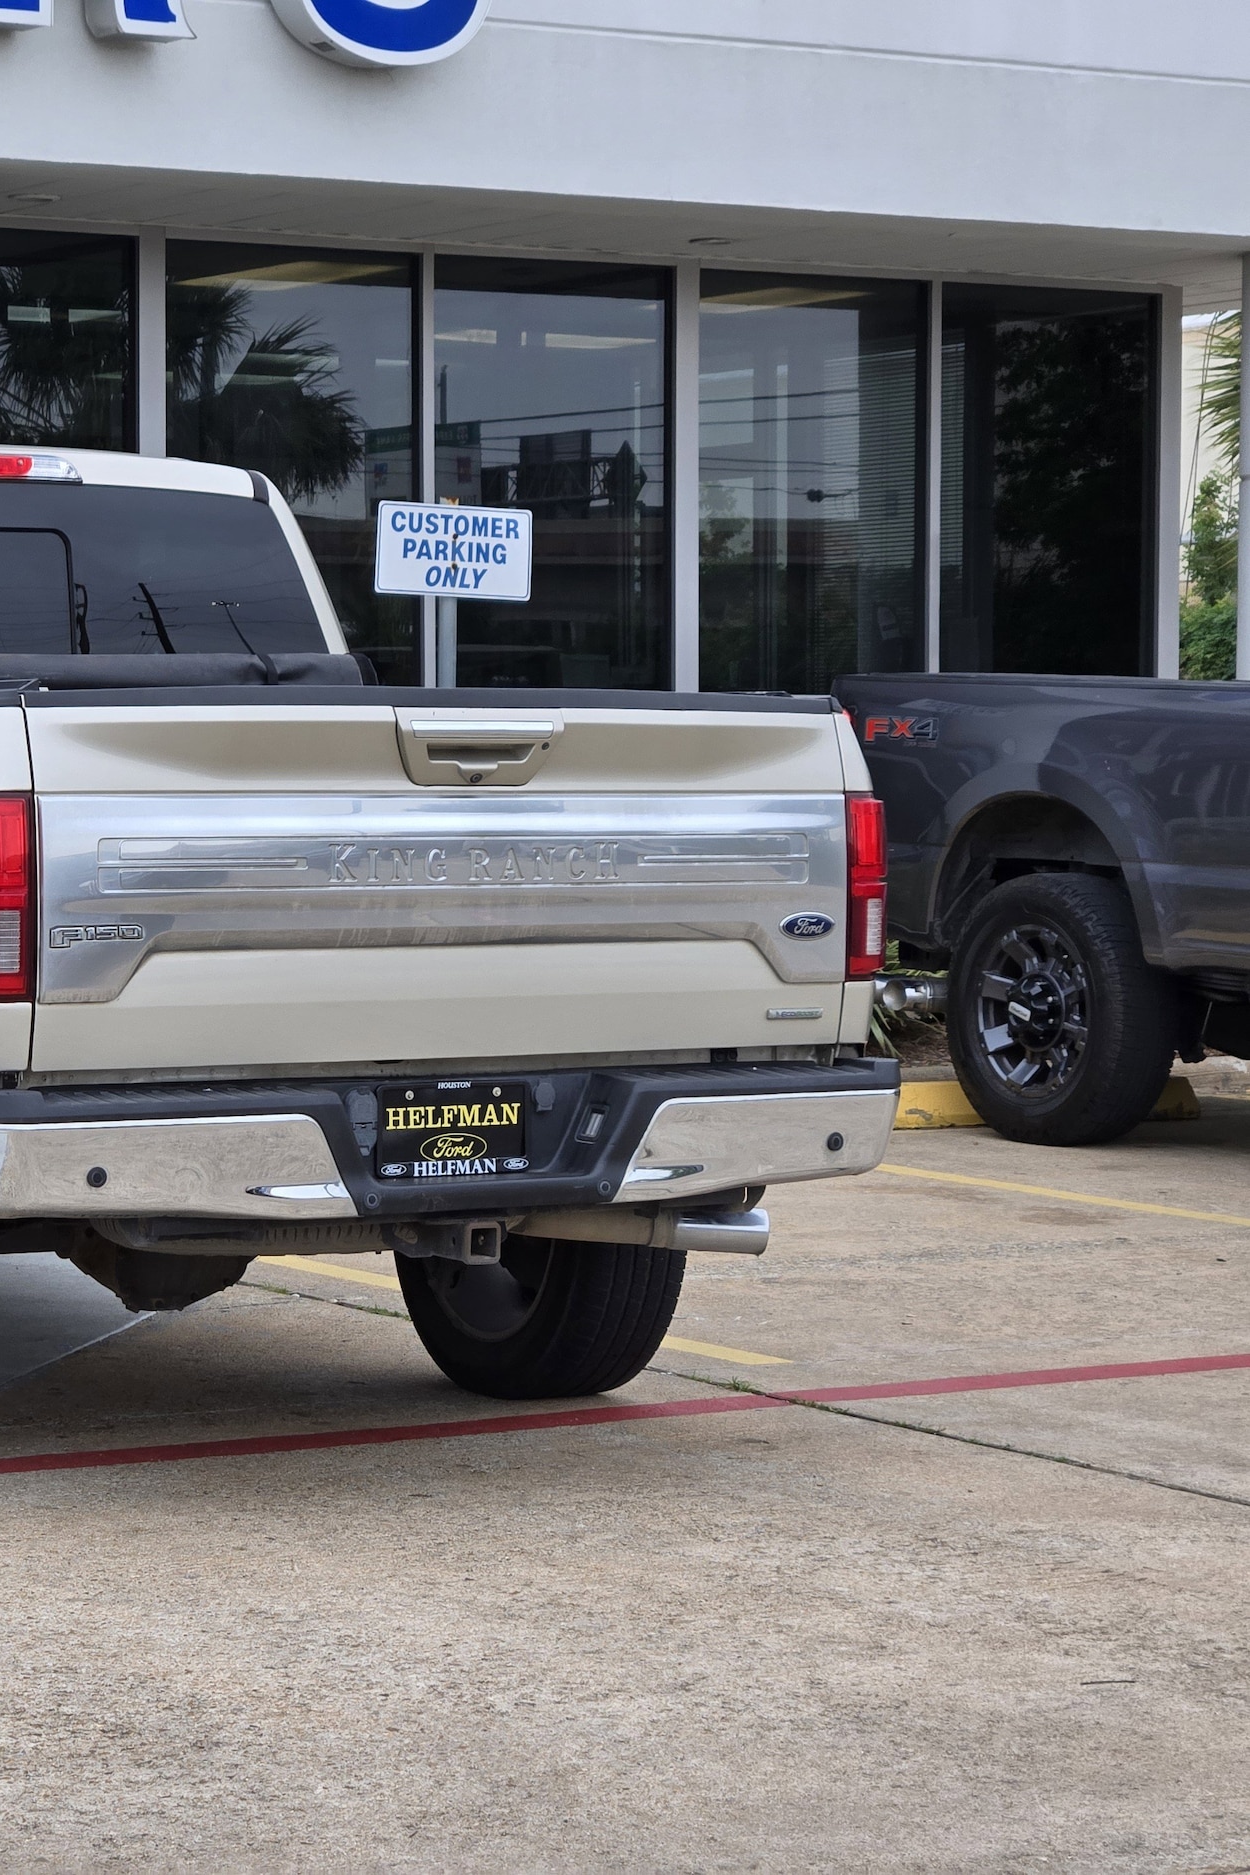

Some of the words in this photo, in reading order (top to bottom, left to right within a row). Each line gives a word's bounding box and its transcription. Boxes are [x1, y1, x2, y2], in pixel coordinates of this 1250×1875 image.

[391, 511, 520, 540] CUSTOMER
[402, 538, 507, 565] PARKING
[425, 565, 488, 589] ONLY
[864, 715, 939, 743] FX4
[328, 843, 447, 883] KING
[468, 842, 620, 881] RANCH
[793, 917, 825, 934] Ford
[437, 1081, 471, 1090] HOUSTON
[385, 1102, 521, 1131] HELFMAN
[433, 1136, 475, 1158] Ford
[413, 1157, 497, 1177] HELFMAN
